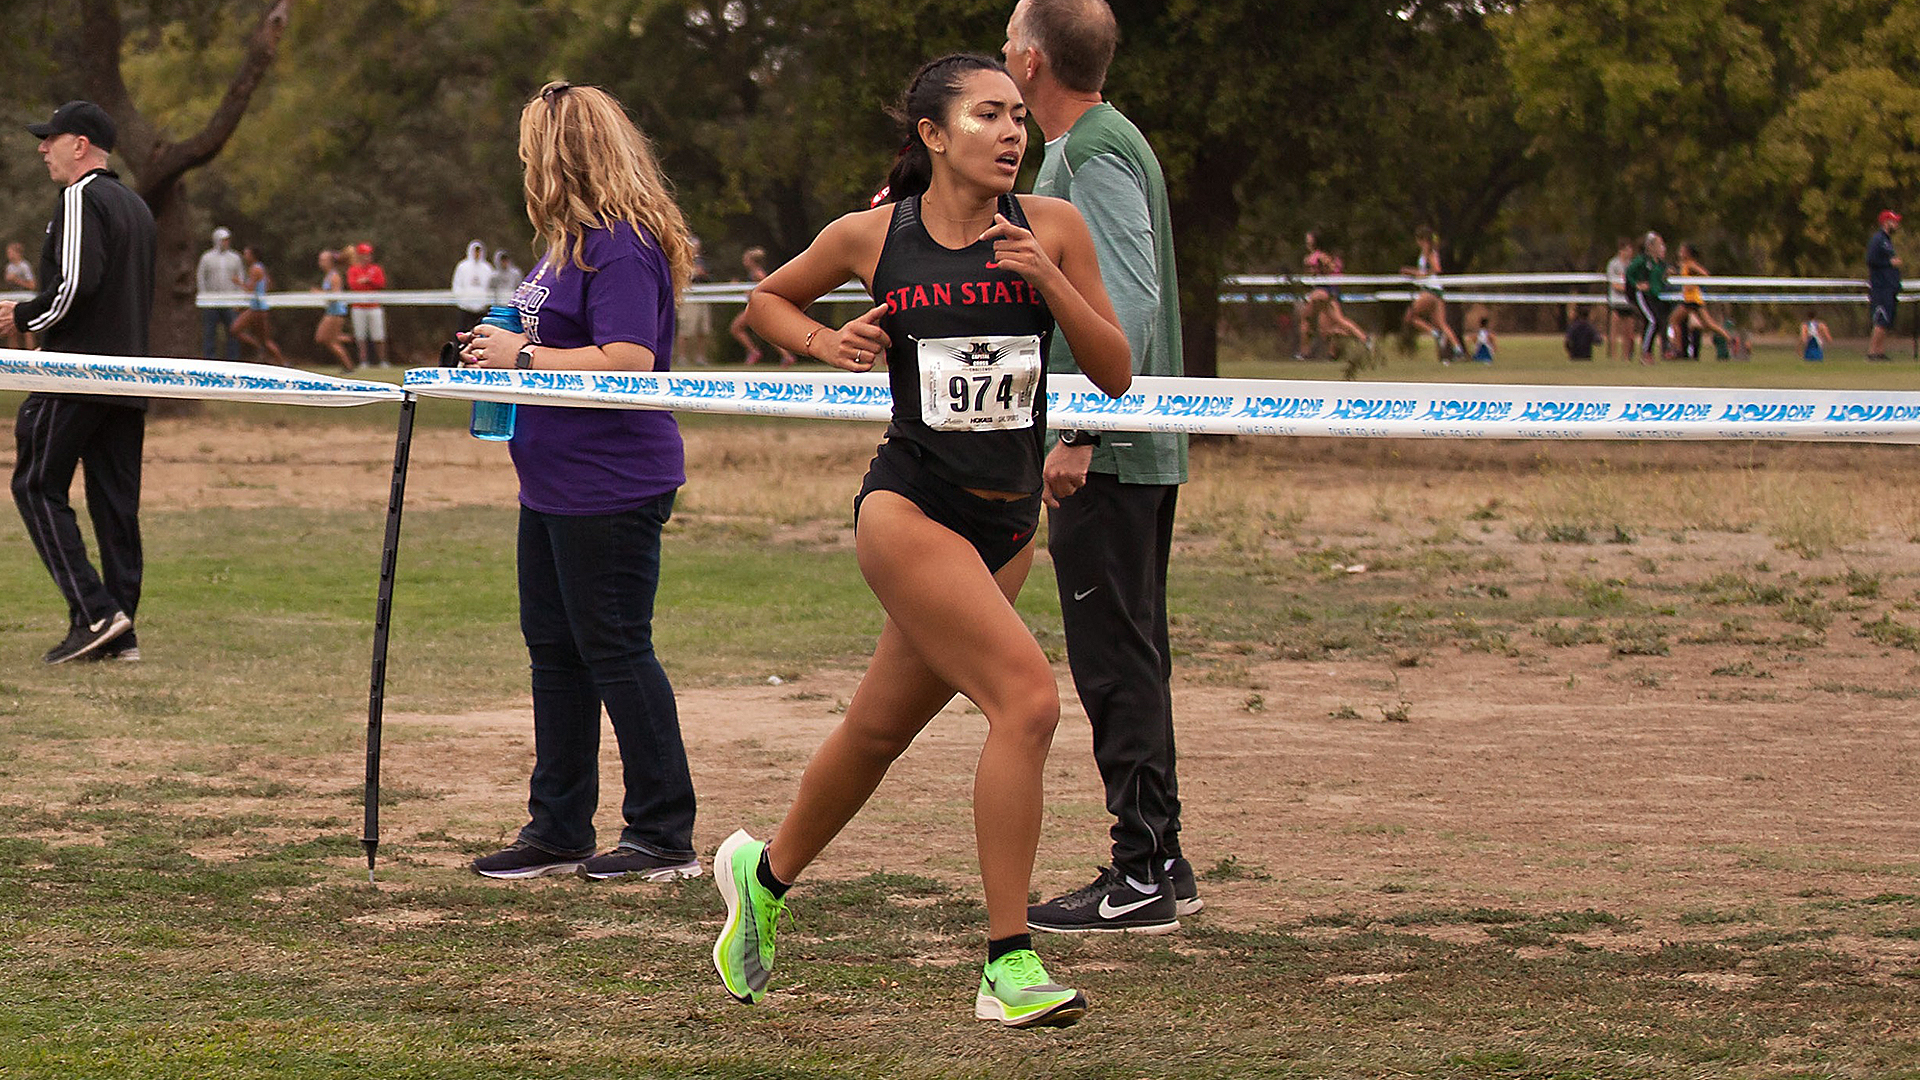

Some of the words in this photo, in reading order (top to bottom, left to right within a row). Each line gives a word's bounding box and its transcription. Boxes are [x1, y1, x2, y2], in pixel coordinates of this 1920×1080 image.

[886, 283, 951, 314] STAN
[961, 281, 1039, 305] STATE
[949, 374, 1013, 412] 974
